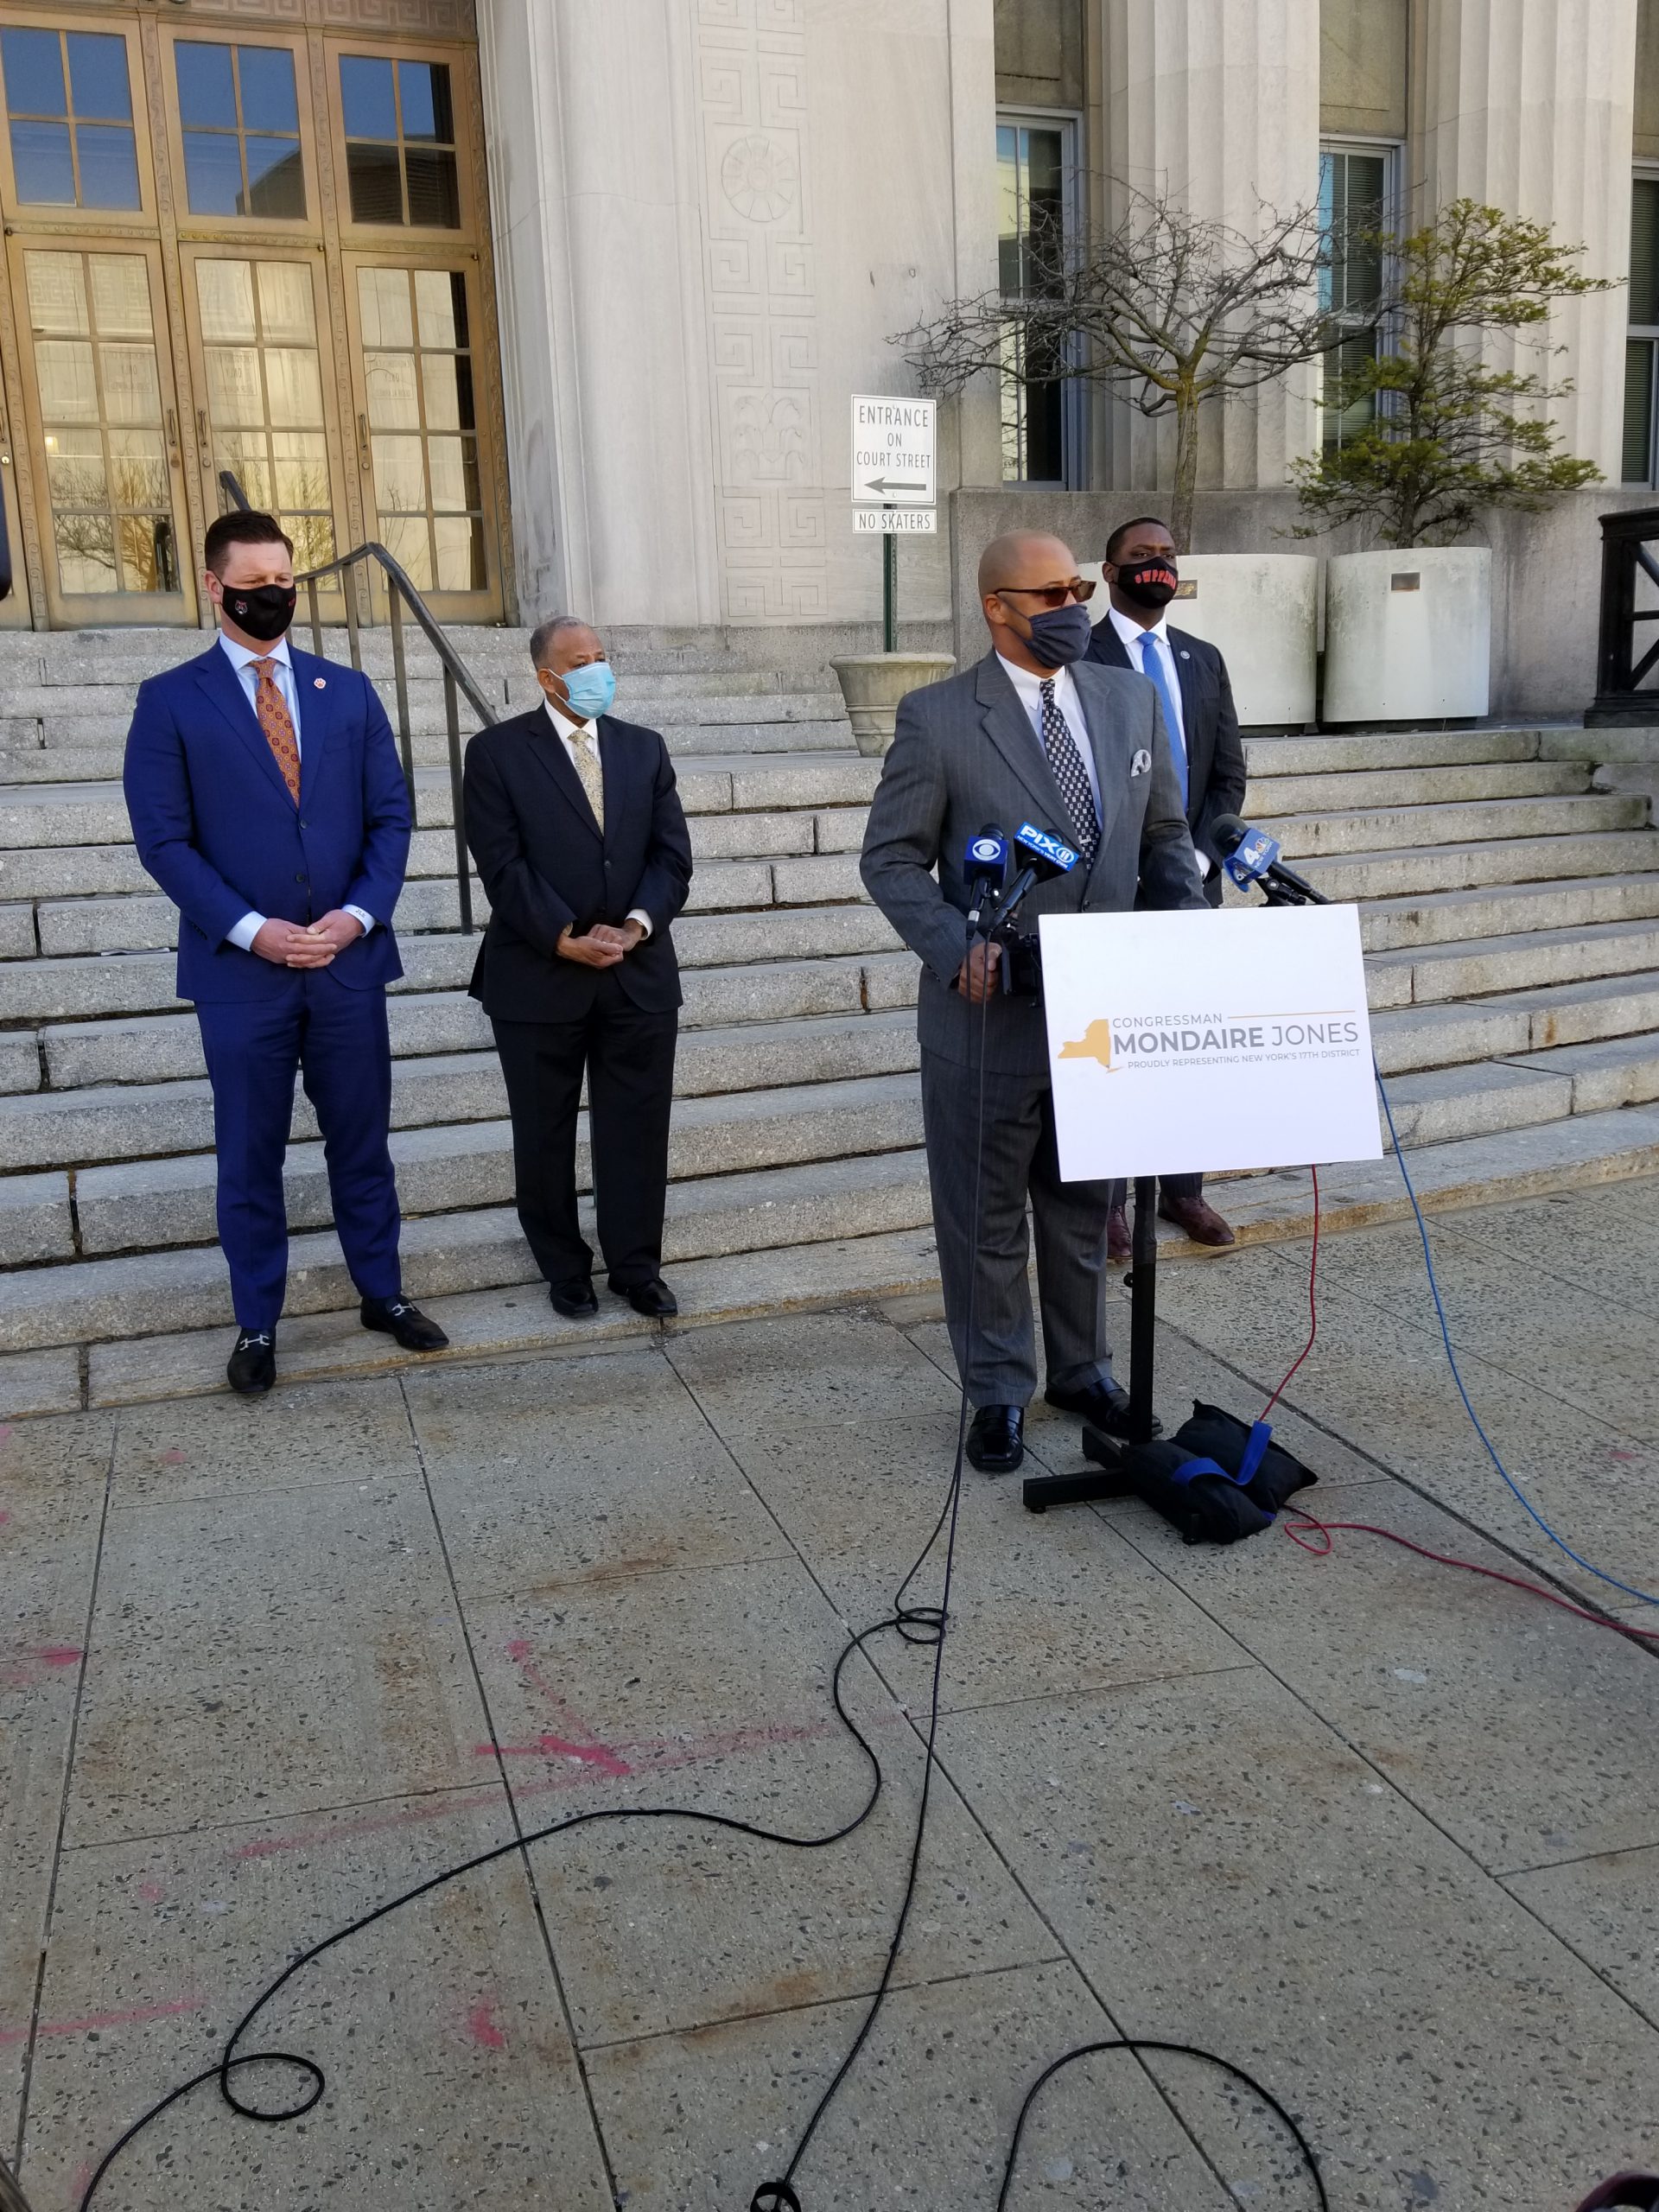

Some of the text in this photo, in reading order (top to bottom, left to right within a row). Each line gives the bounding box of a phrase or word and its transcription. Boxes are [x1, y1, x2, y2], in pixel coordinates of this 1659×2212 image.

[860, 405, 928, 427] ENTRANCE
[887, 432, 902, 447] ON
[856, 451, 931, 468] COURT STREET
[859, 513, 931, 530] NO SKATERS
[1244, 847, 1261, 865] 4
[1255, 842, 1274, 868] NEW YORK
[1113, 1013, 1222, 1028] CONGRESSMAN
[1114, 1022, 1358, 1055] MONDAIRE JONES
[1128, 1048, 1360, 1069] PROUDLY REPRESENTING NEW YORK'S 17TH DISTRICT
